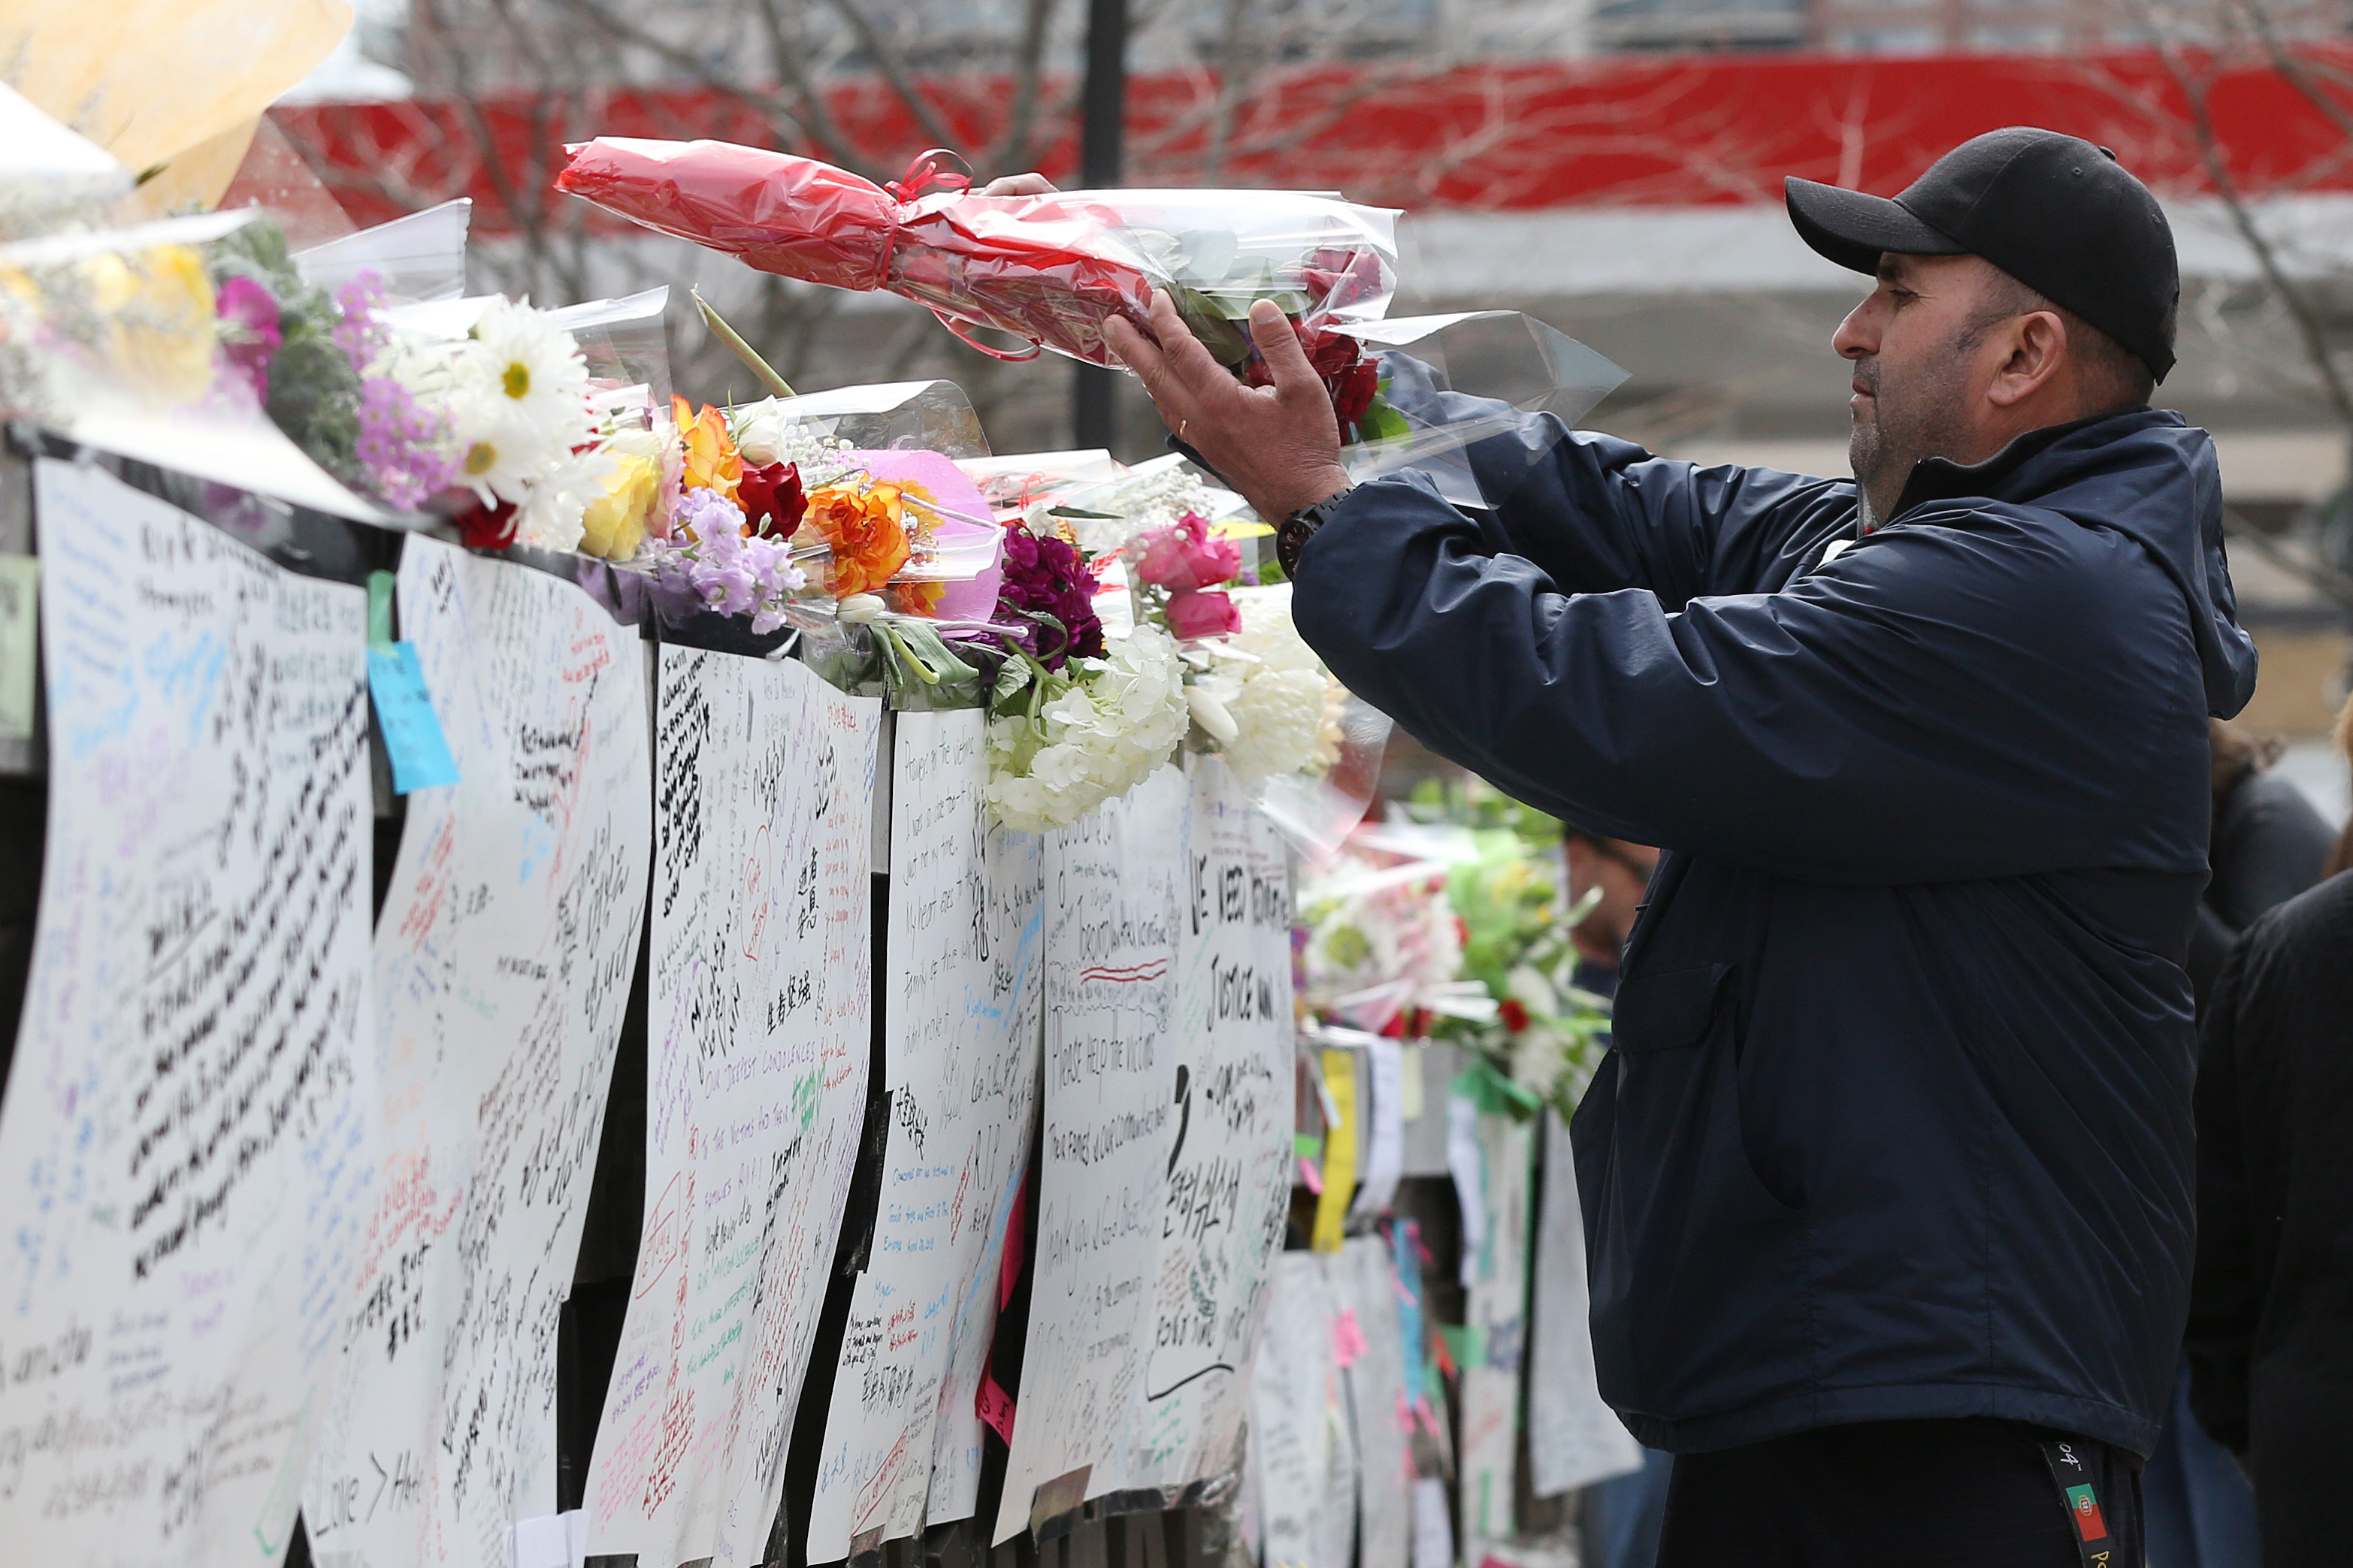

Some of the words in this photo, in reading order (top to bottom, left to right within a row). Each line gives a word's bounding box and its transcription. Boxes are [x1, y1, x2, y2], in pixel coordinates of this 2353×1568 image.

[1206, 952, 1254, 1033] JUSTICE
[761, 1043, 815, 1074] CONDOLENCES
[1052, 1008, 1081, 1098] PLEASE
[1087, 1033, 1108, 1104] HELP
[314, 1454, 360, 1539] Love
